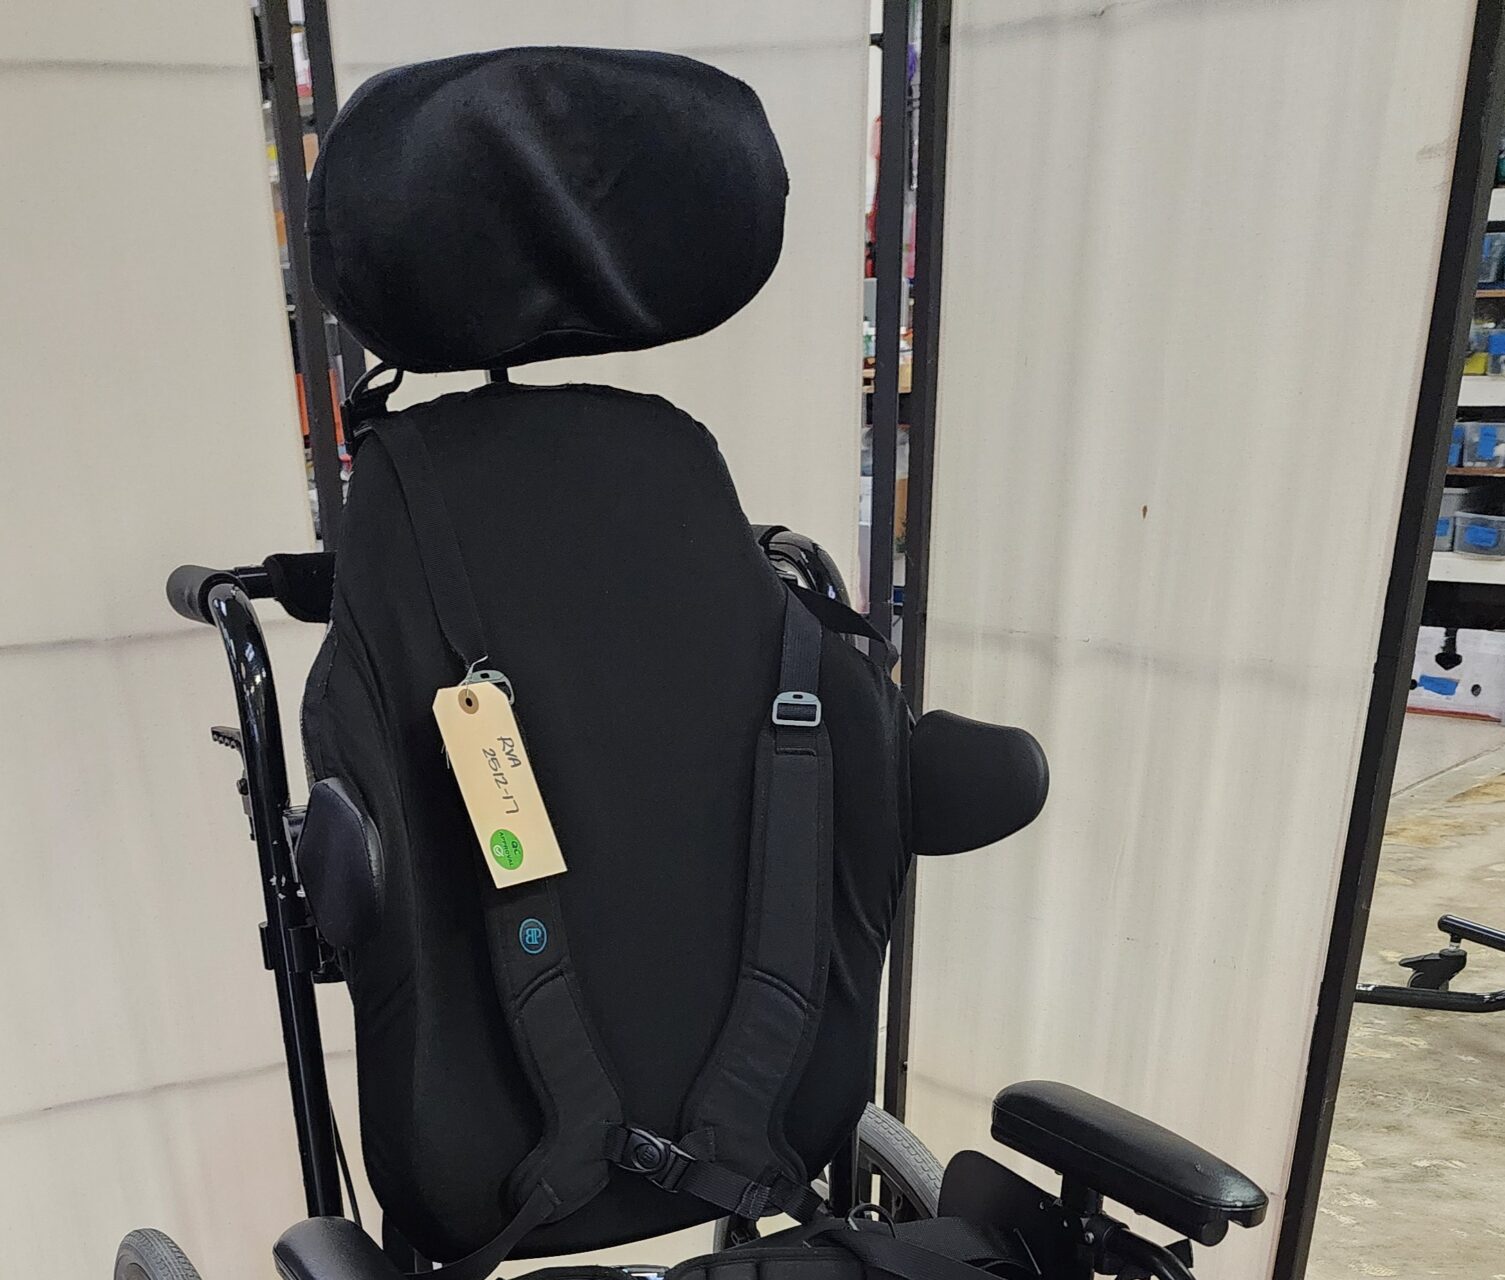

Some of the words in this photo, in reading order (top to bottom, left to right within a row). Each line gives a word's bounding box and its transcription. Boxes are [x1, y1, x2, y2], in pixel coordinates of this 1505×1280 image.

[497, 735, 522, 769] RVA
[482, 747, 520, 815] 2512-17
[498, 831, 514, 867] APPROVAL
[510, 840, 522, 856] QC
